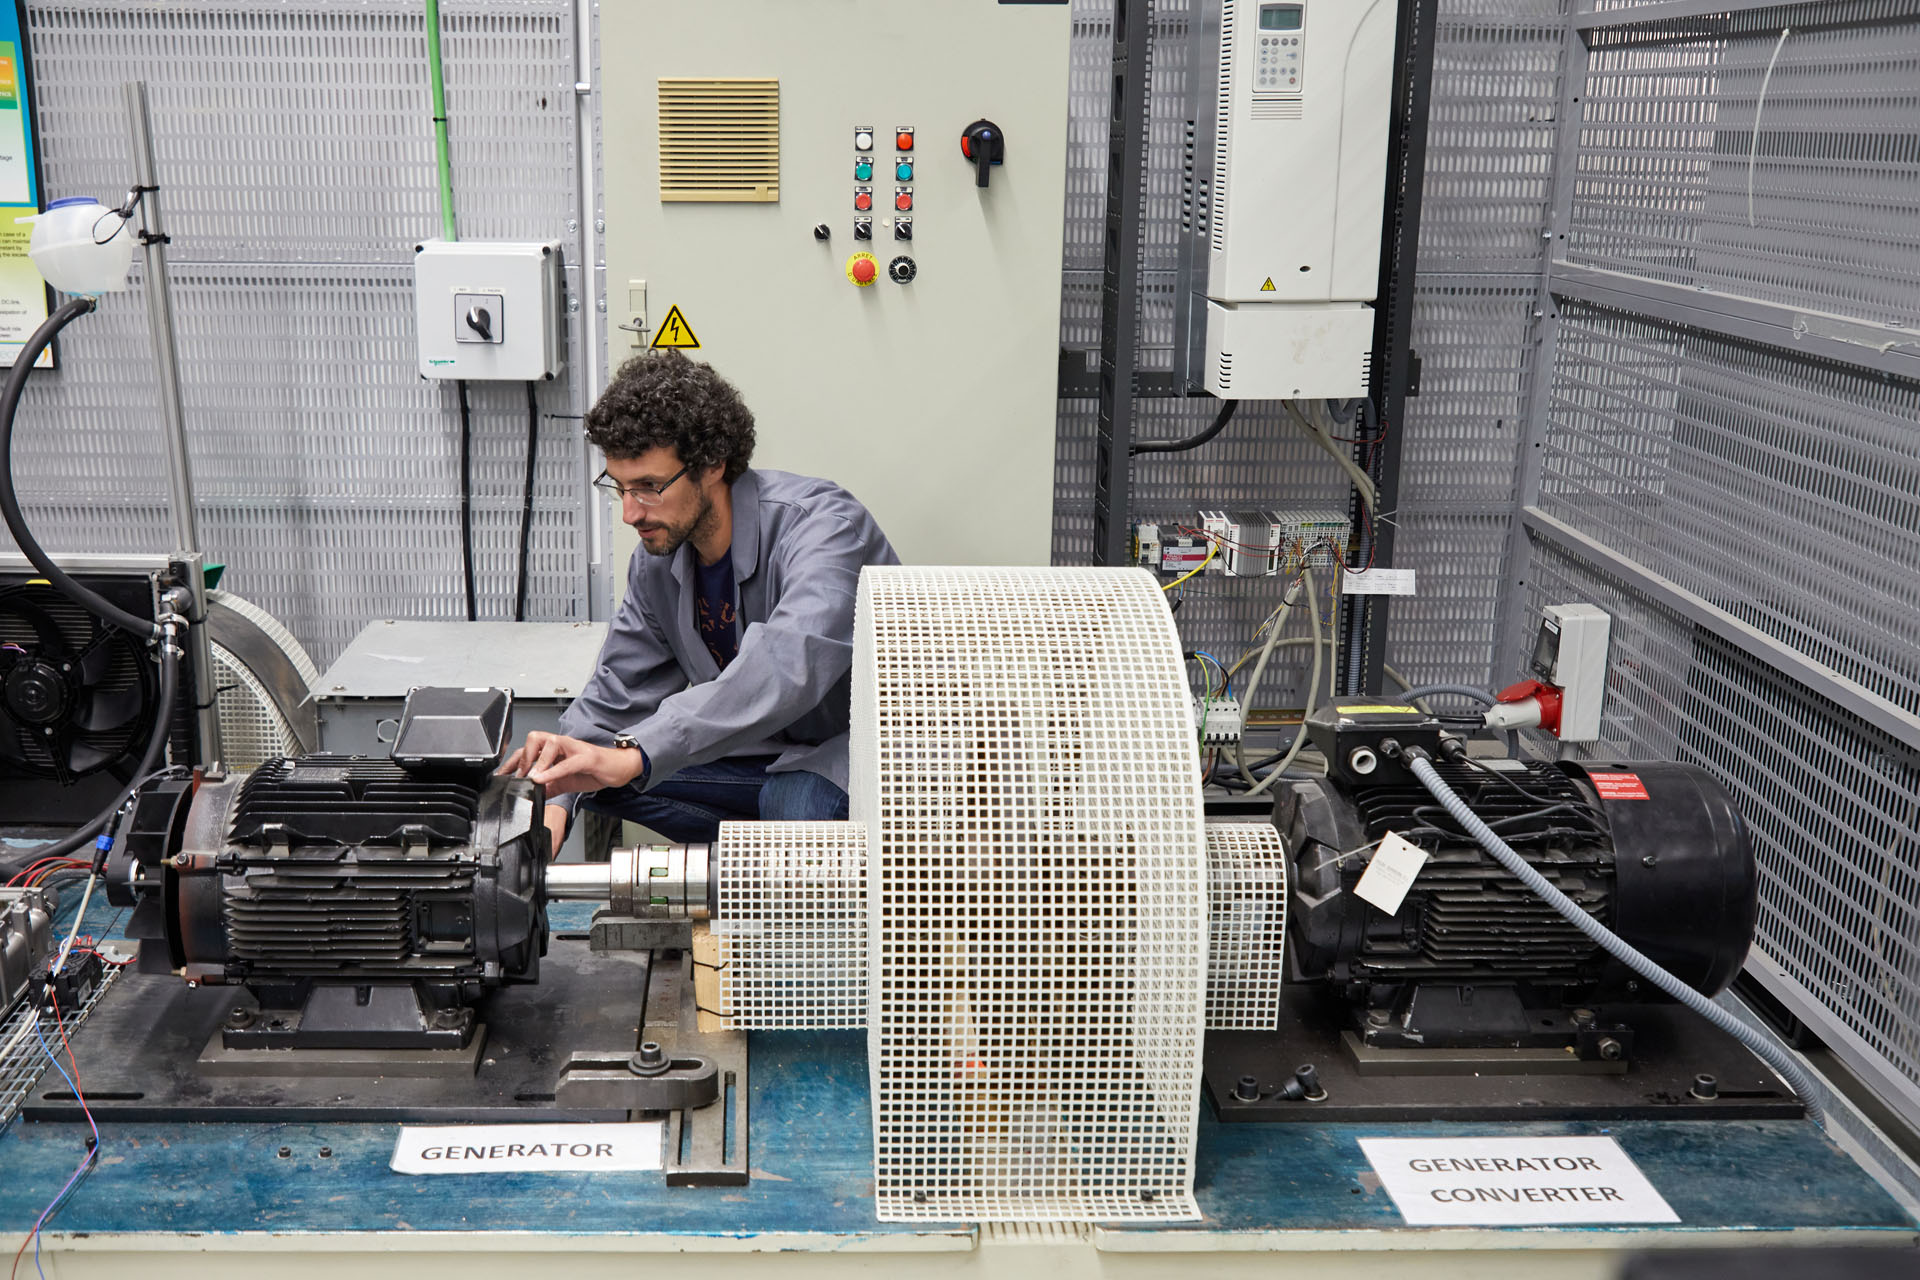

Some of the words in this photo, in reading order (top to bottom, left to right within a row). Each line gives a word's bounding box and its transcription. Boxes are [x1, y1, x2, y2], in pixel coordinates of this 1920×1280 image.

[421, 1143, 614, 1160] GENERATOR
[1409, 1157, 1602, 1172] GENERATOR
[1430, 1187, 1625, 1202] CONVERTER
